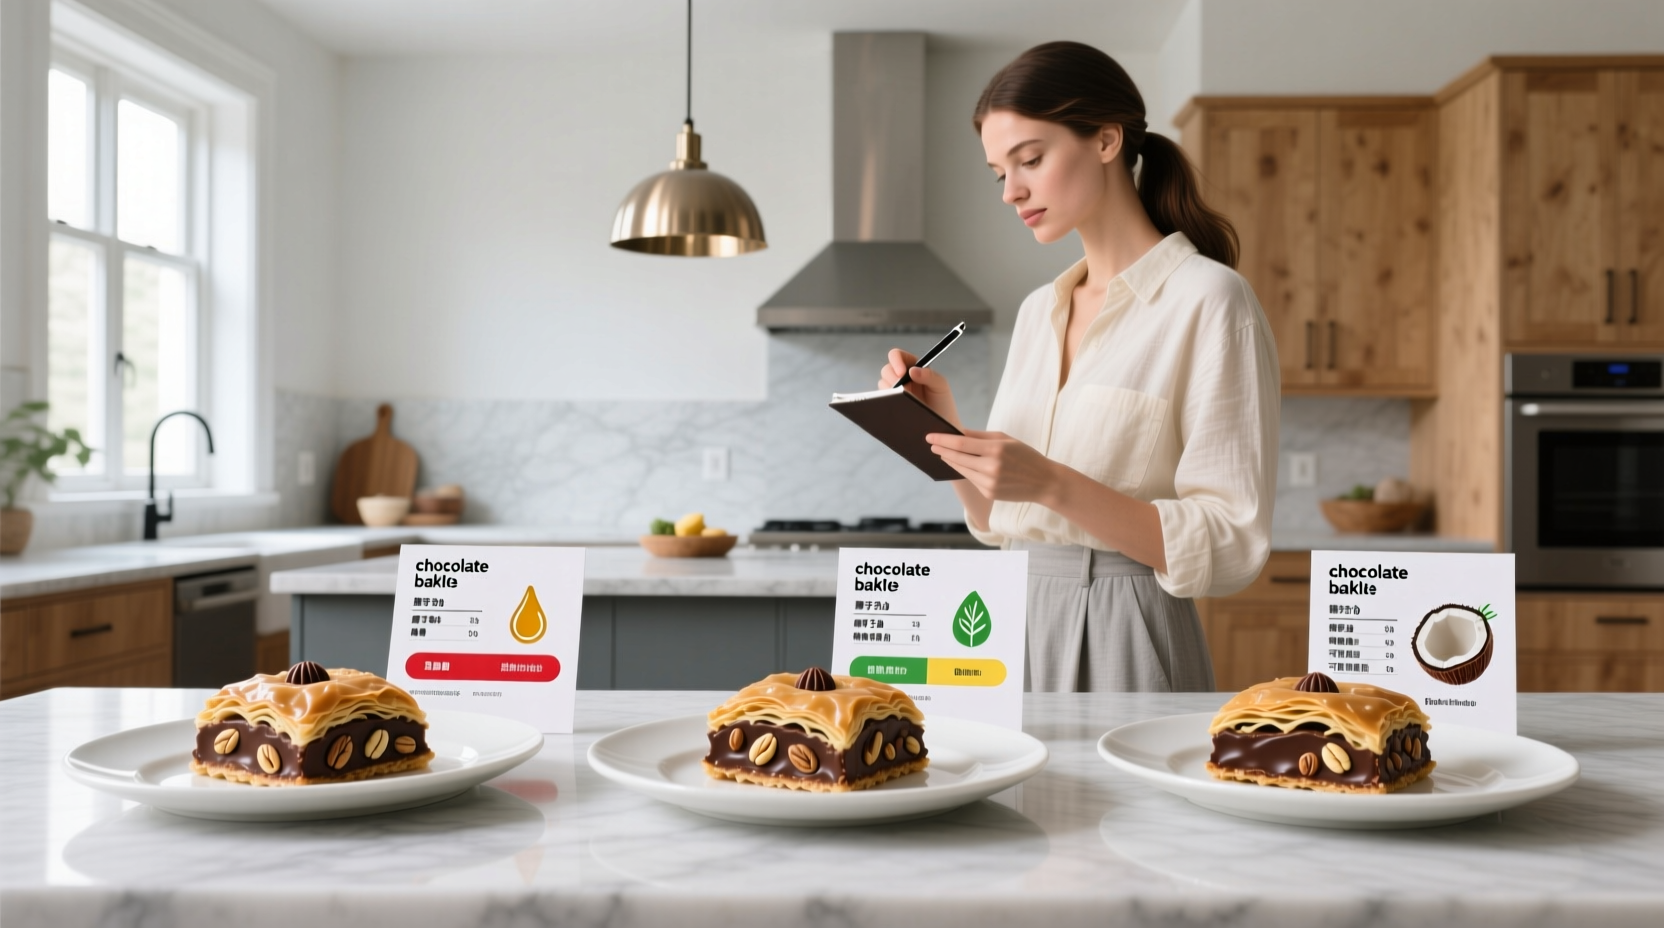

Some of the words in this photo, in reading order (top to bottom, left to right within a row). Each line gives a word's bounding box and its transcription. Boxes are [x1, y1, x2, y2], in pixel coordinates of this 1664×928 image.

[415, 558, 489, 573] chocolate
[855, 561, 931, 577] chocolate
[1328, 563, 1409, 580] chocolate
